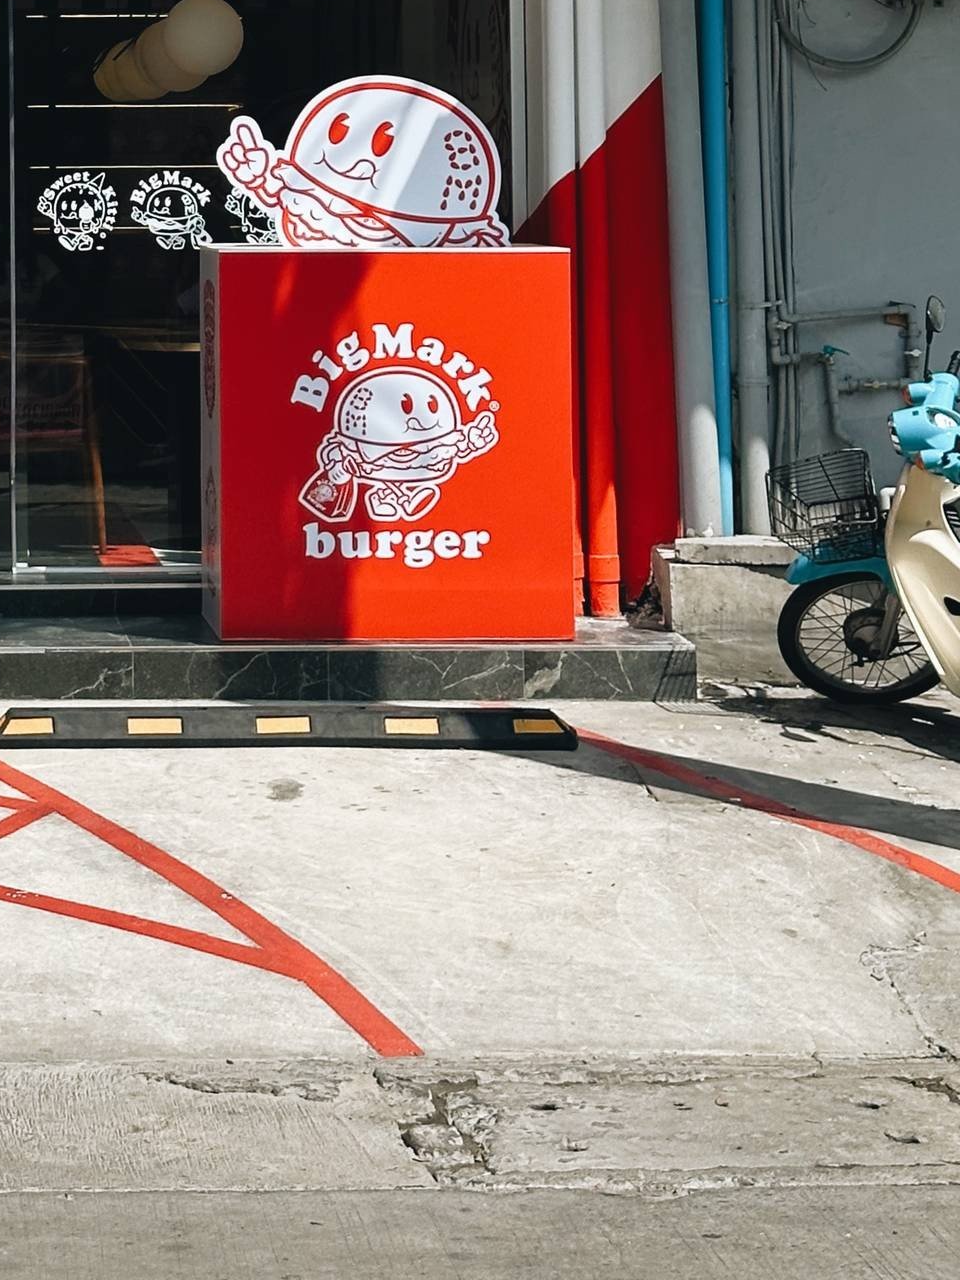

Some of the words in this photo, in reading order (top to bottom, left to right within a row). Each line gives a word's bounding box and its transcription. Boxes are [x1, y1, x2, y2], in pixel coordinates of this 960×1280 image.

[43, 171, 91, 200] Sweet
[129, 170, 213, 208] BigMark
[290, 322, 494, 413] BigMark
[302, 522, 491, 568] burger
